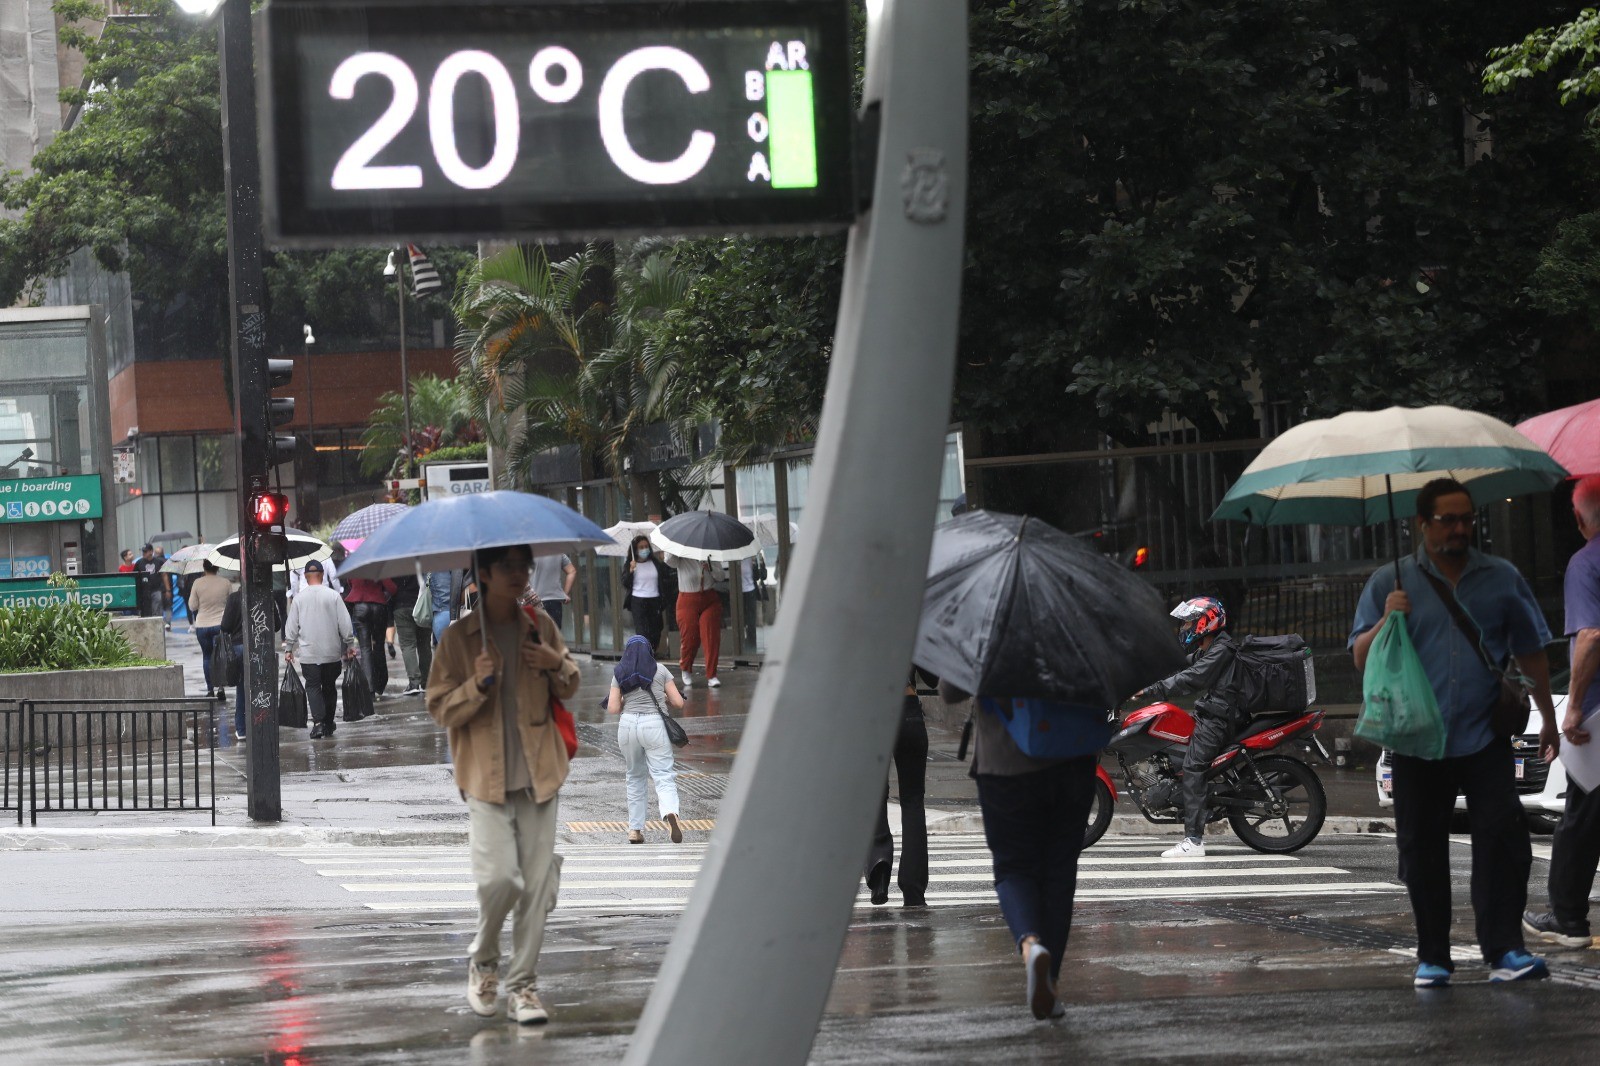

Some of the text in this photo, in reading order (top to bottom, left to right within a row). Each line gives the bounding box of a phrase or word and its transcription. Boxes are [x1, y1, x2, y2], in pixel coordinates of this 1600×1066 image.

[765, 40, 809, 71] AR
[329, 46, 716, 190] 20°C
[22, 481, 72, 492] boarding
[66, 592, 113, 607] Masp
